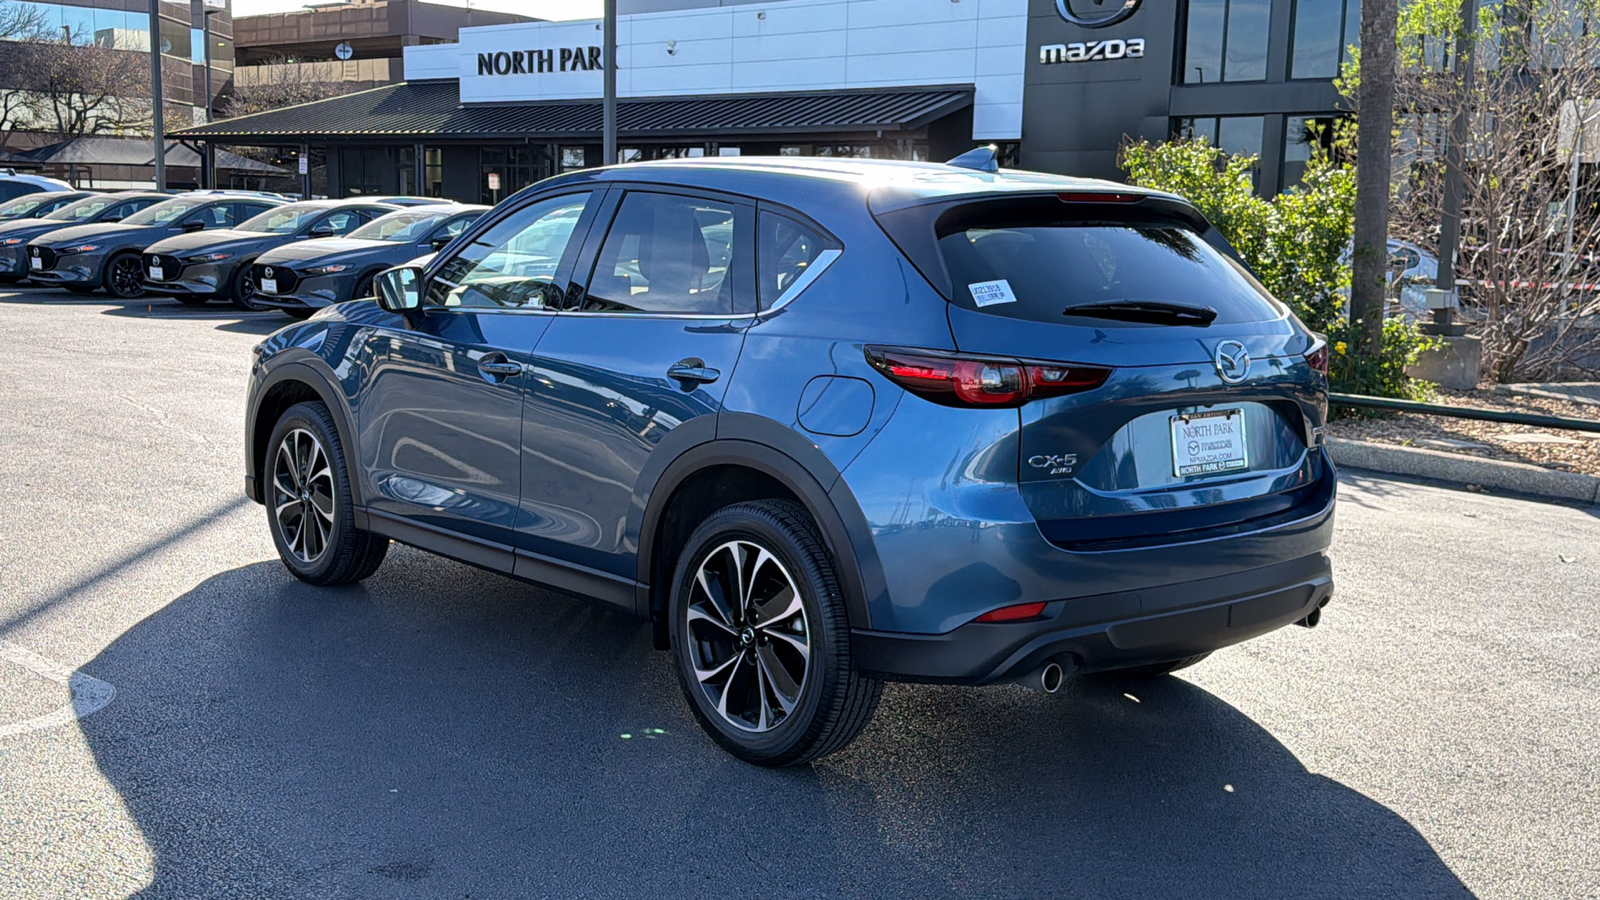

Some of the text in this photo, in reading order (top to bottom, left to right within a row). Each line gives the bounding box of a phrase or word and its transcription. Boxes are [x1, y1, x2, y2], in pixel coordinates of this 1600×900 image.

[1040, 38, 1145, 64] mazda
[477, 46, 619, 76] NORTH PAR
[1182, 422, 1234, 439] NORTH PARK
[1028, 453, 1077, 468] CX-5
[1180, 465, 1202, 475] NORTH
[1202, 462, 1219, 472] PARK
[1050, 467, 1072, 475] AWD
